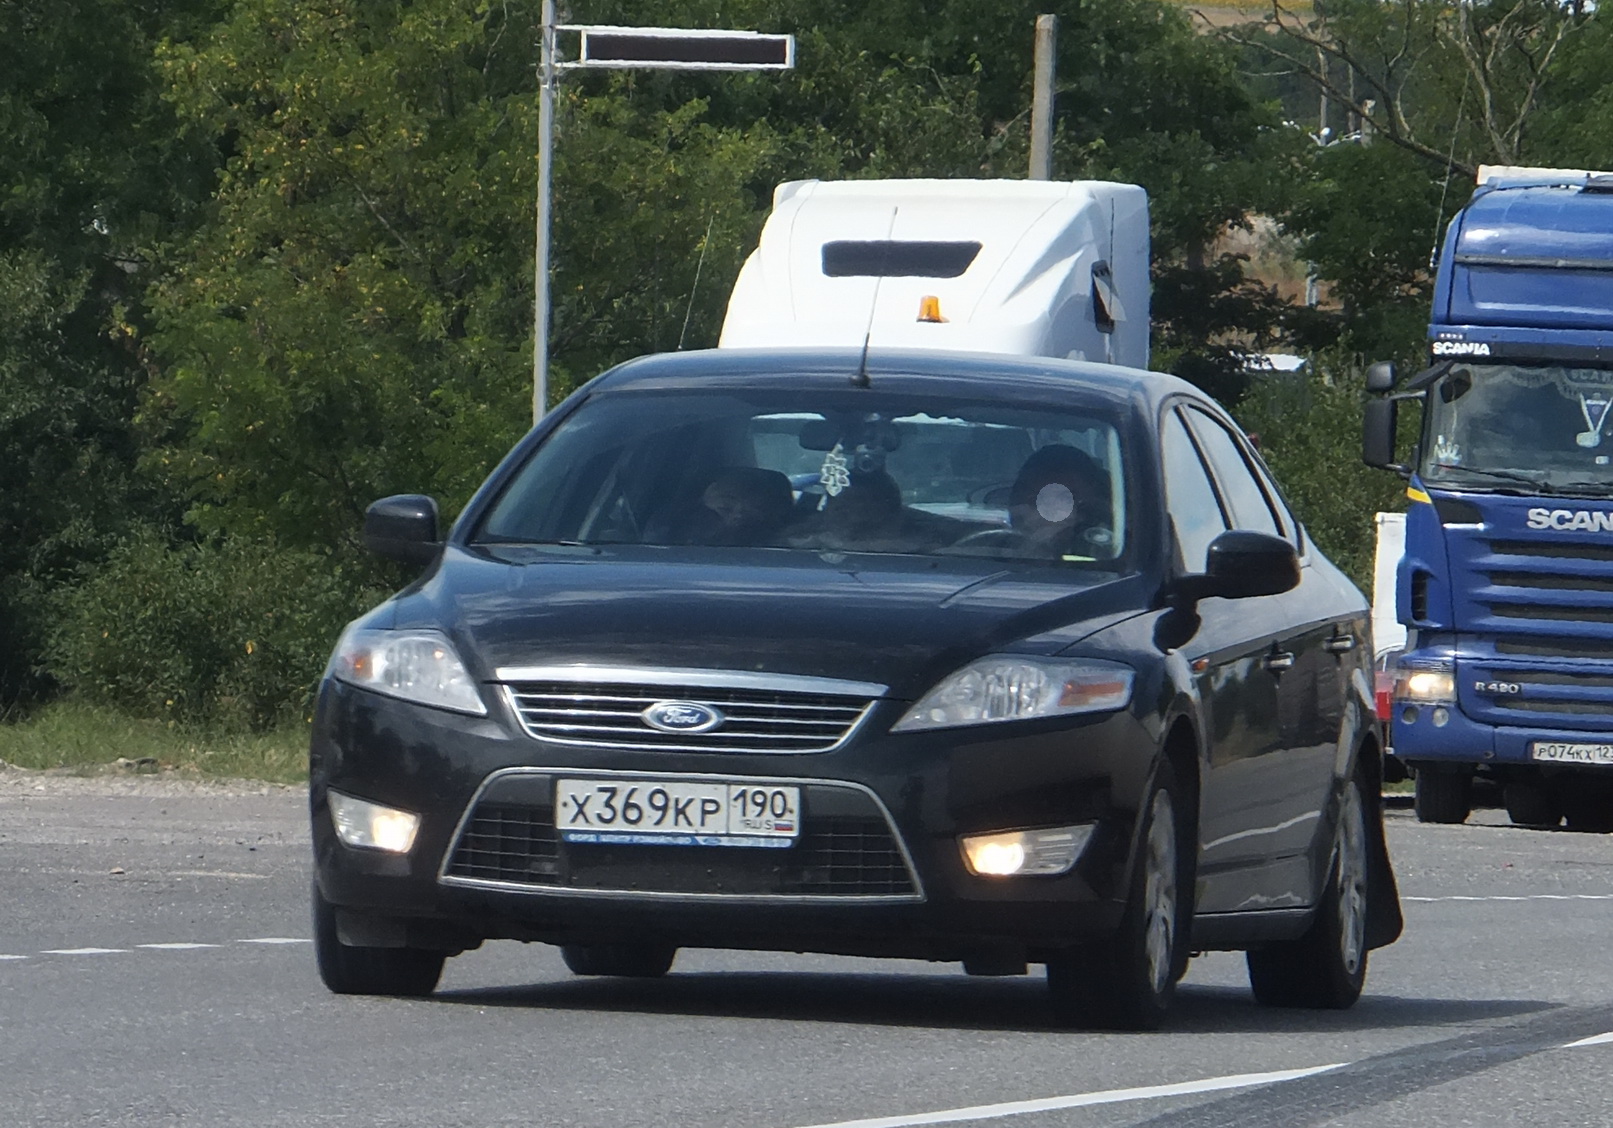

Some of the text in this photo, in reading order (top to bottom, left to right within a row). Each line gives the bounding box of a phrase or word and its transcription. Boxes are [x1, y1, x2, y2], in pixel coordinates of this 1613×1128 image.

[1432, 341, 1490, 356] SCANIA
[662, 707, 701, 723] Ford
[733, 788, 787, 818] 190
